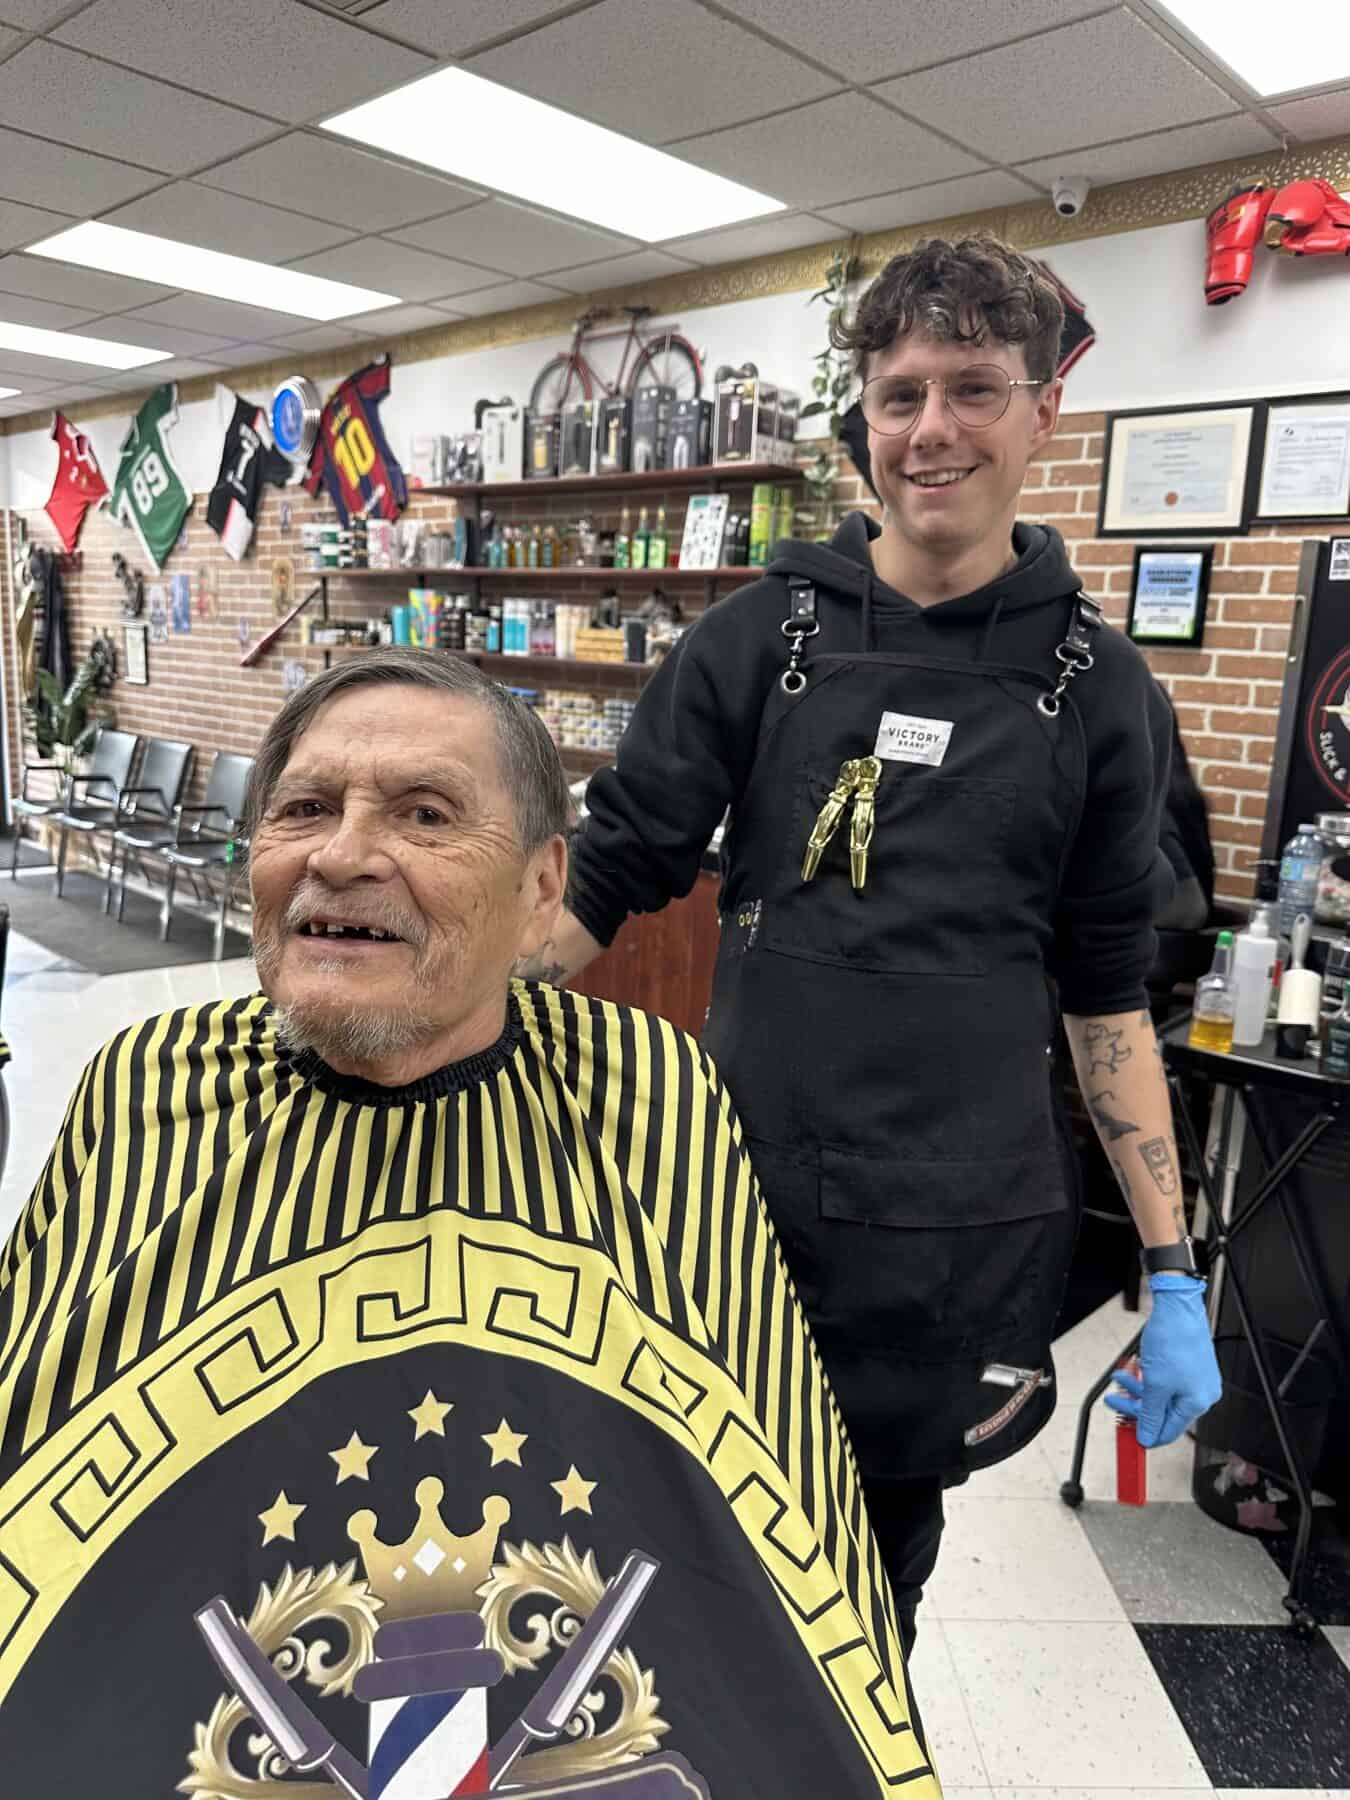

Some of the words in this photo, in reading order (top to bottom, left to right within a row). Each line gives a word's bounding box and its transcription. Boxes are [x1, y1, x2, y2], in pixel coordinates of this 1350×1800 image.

[133, 452, 169, 515] 89
[334, 418, 375, 489] 10
[888, 727, 940, 743] VICTORY
